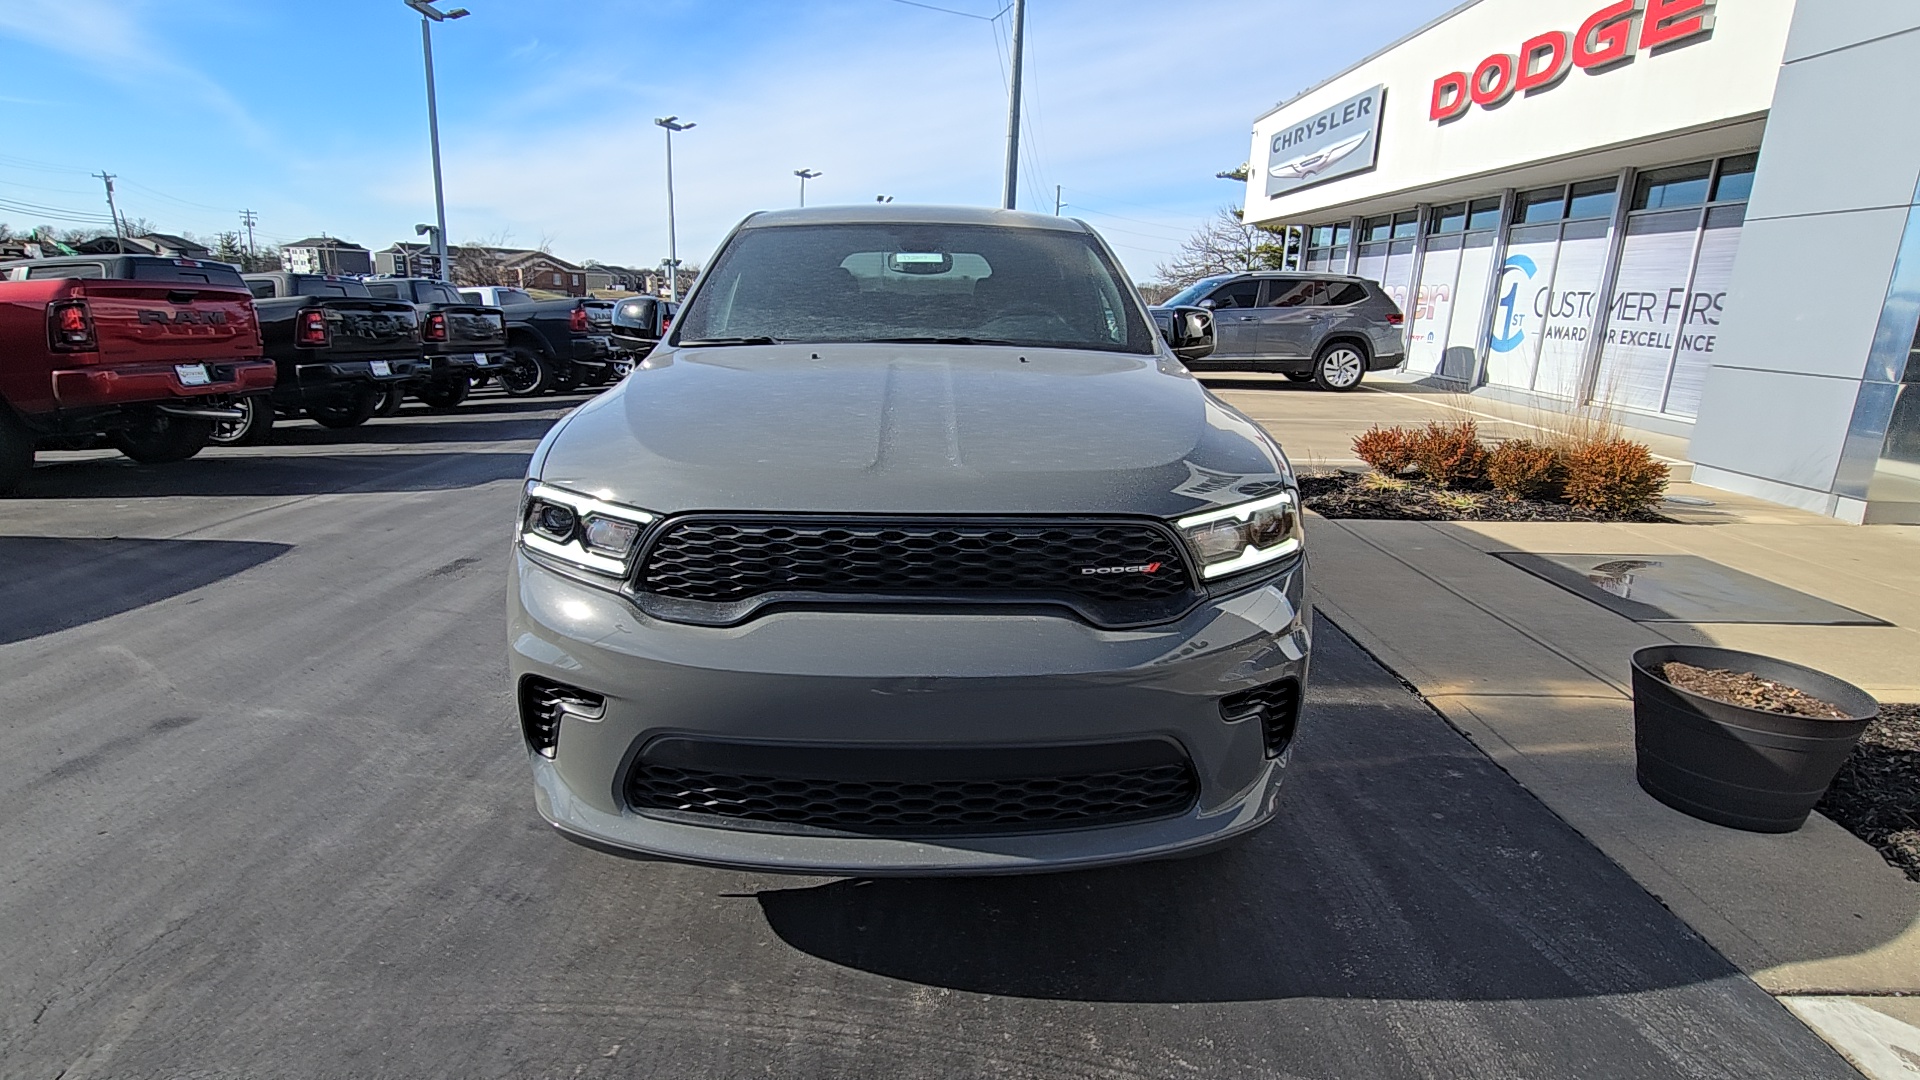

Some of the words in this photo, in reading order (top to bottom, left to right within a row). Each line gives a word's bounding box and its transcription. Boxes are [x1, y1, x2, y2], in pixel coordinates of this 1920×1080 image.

[1429, 0, 1716, 121] DODGE
[1272, 96, 1372, 153] CHRYSLER
[138, 310, 226, 325] RAM
[1545, 327, 1587, 341] AWARD
[1619, 329, 1716, 352] EXCELLNCE
[1082, 565, 1151, 575] DODGE
